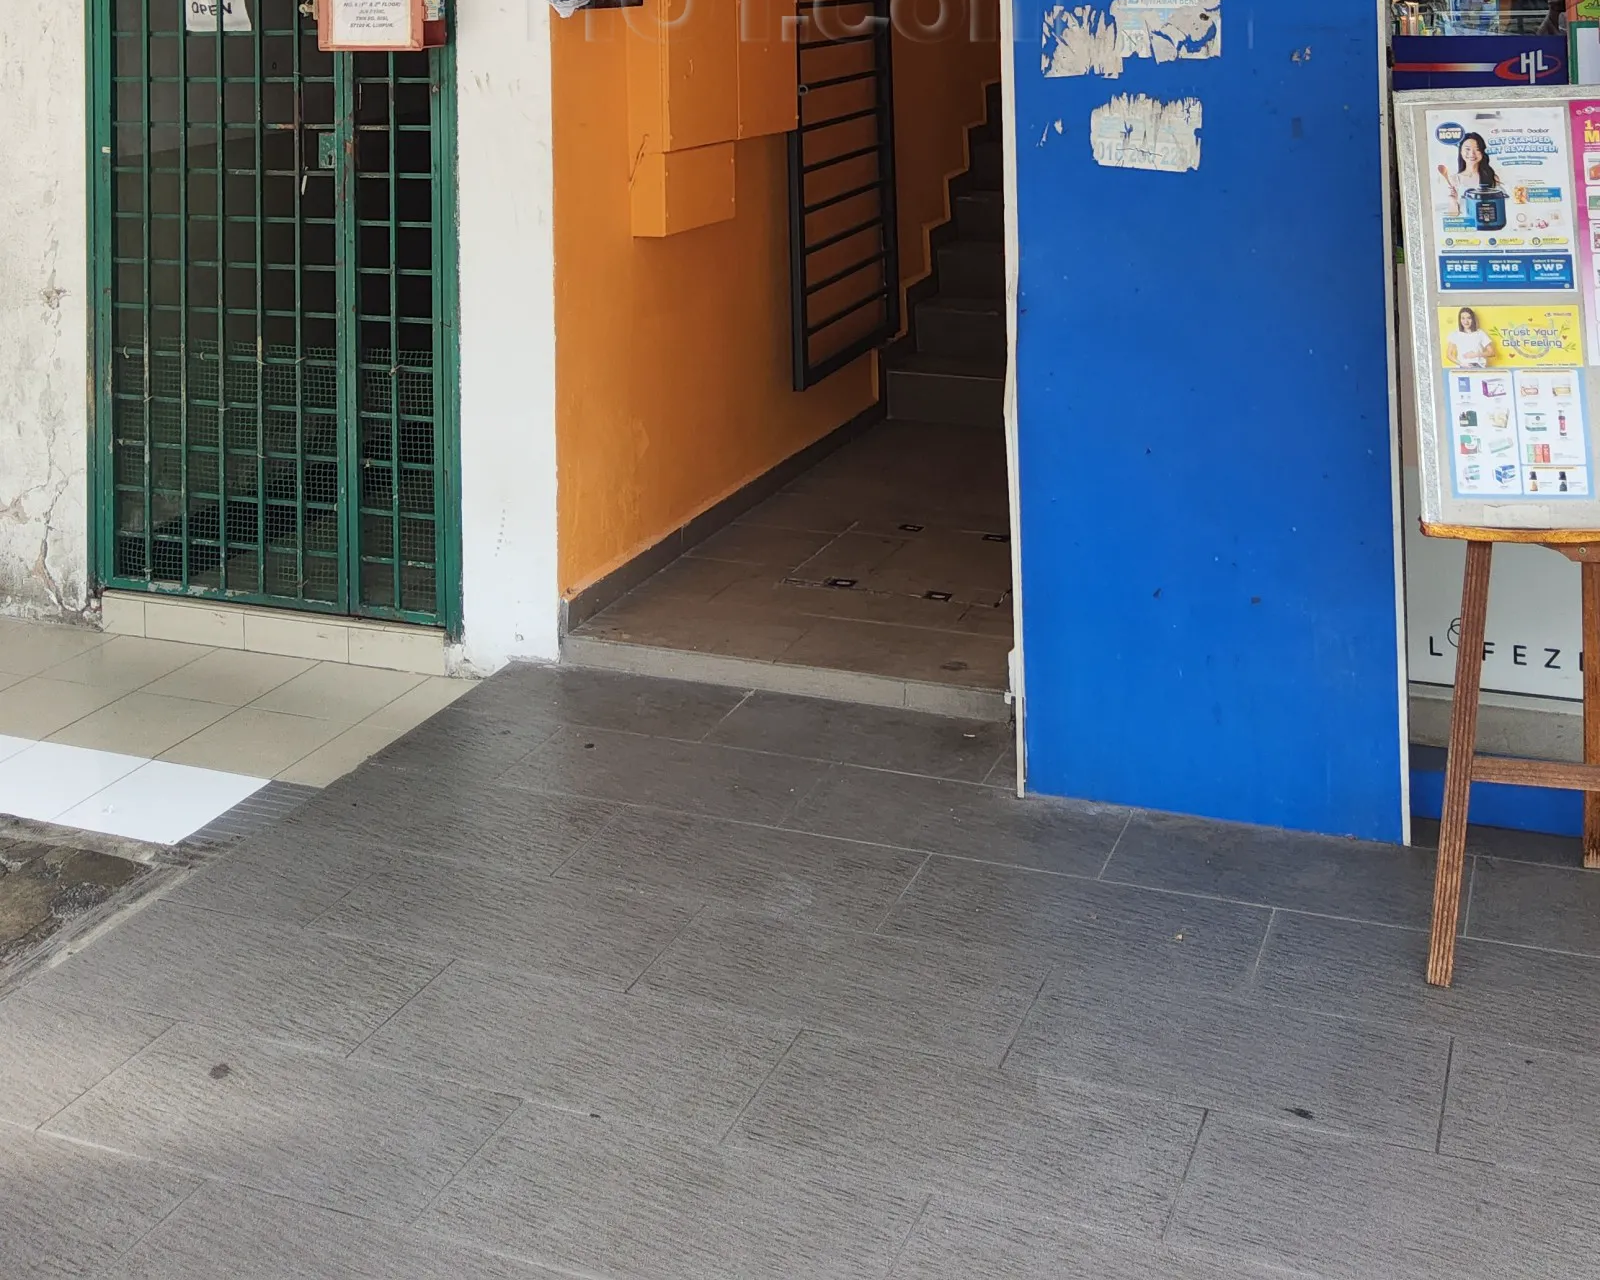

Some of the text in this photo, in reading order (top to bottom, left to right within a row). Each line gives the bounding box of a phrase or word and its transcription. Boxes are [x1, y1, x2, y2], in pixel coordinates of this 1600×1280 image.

[191, 1, 233, 16] OPEN
[1520, 49, 1549, 85] HL
[1438, 131, 1461, 140] NOW
[1487, 136, 1506, 146] GET
[1486, 146, 1503, 155] GET
[1446, 263, 1478, 272] FREE
[1492, 263, 1519, 272] RM8
[1534, 263, 1564, 271] PWP
[1500, 328, 1559, 337] Trust Your
[1502, 338, 1563, 349] Gut Feeling
[1429, 634, 1584, 672] LFEZ
